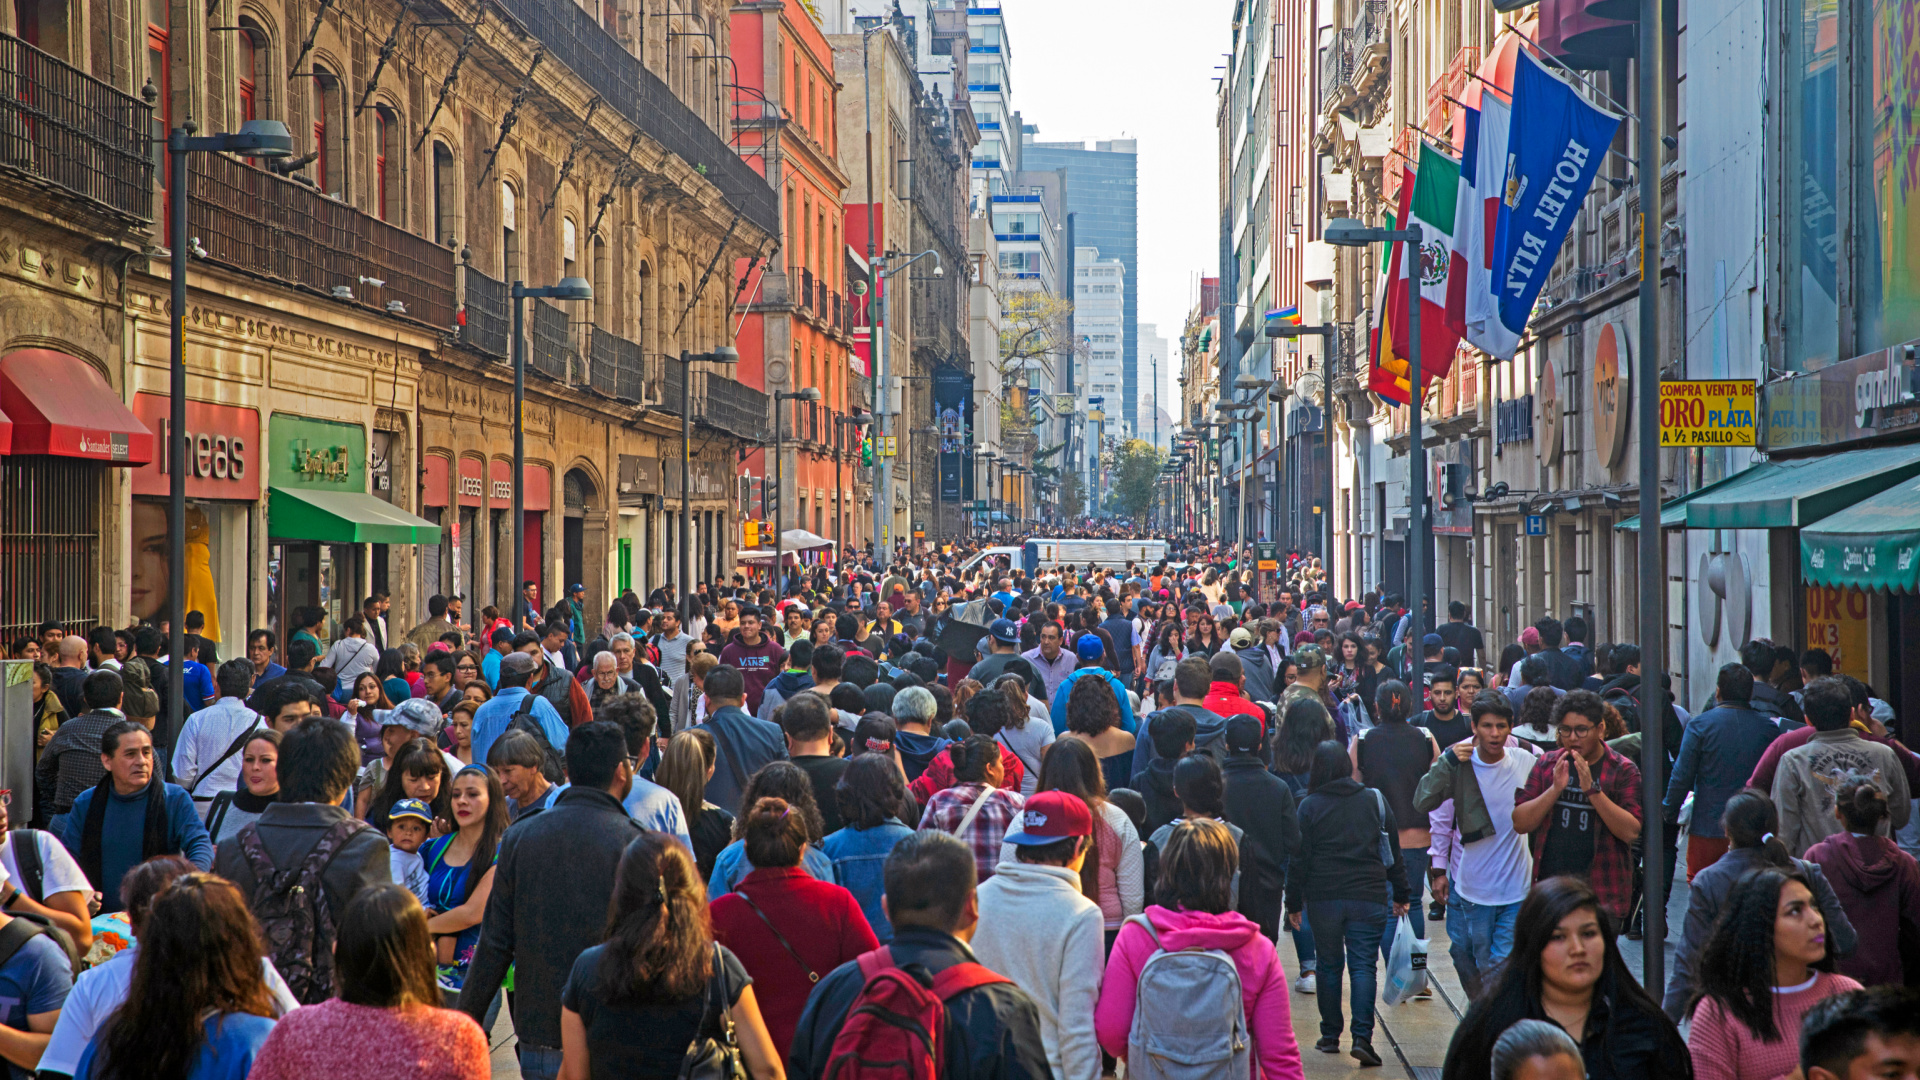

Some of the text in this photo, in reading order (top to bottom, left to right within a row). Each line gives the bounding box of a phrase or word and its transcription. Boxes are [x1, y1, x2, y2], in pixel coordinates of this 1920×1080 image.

[1596, 363, 1616, 433] vips
[1660, 384, 1754, 396] COMPRA VENTA DE
[1660, 397, 1754, 428] ORO Y PLATA
[1661, 431, 1671, 443] A
[1691, 431, 1734, 443] PASILLO
[86, 437, 129, 455] Santander SELECT
[1530, 518, 1543, 533] H
[1809, 585, 1867, 620] ORO
[738, 656, 765, 667] VANS
